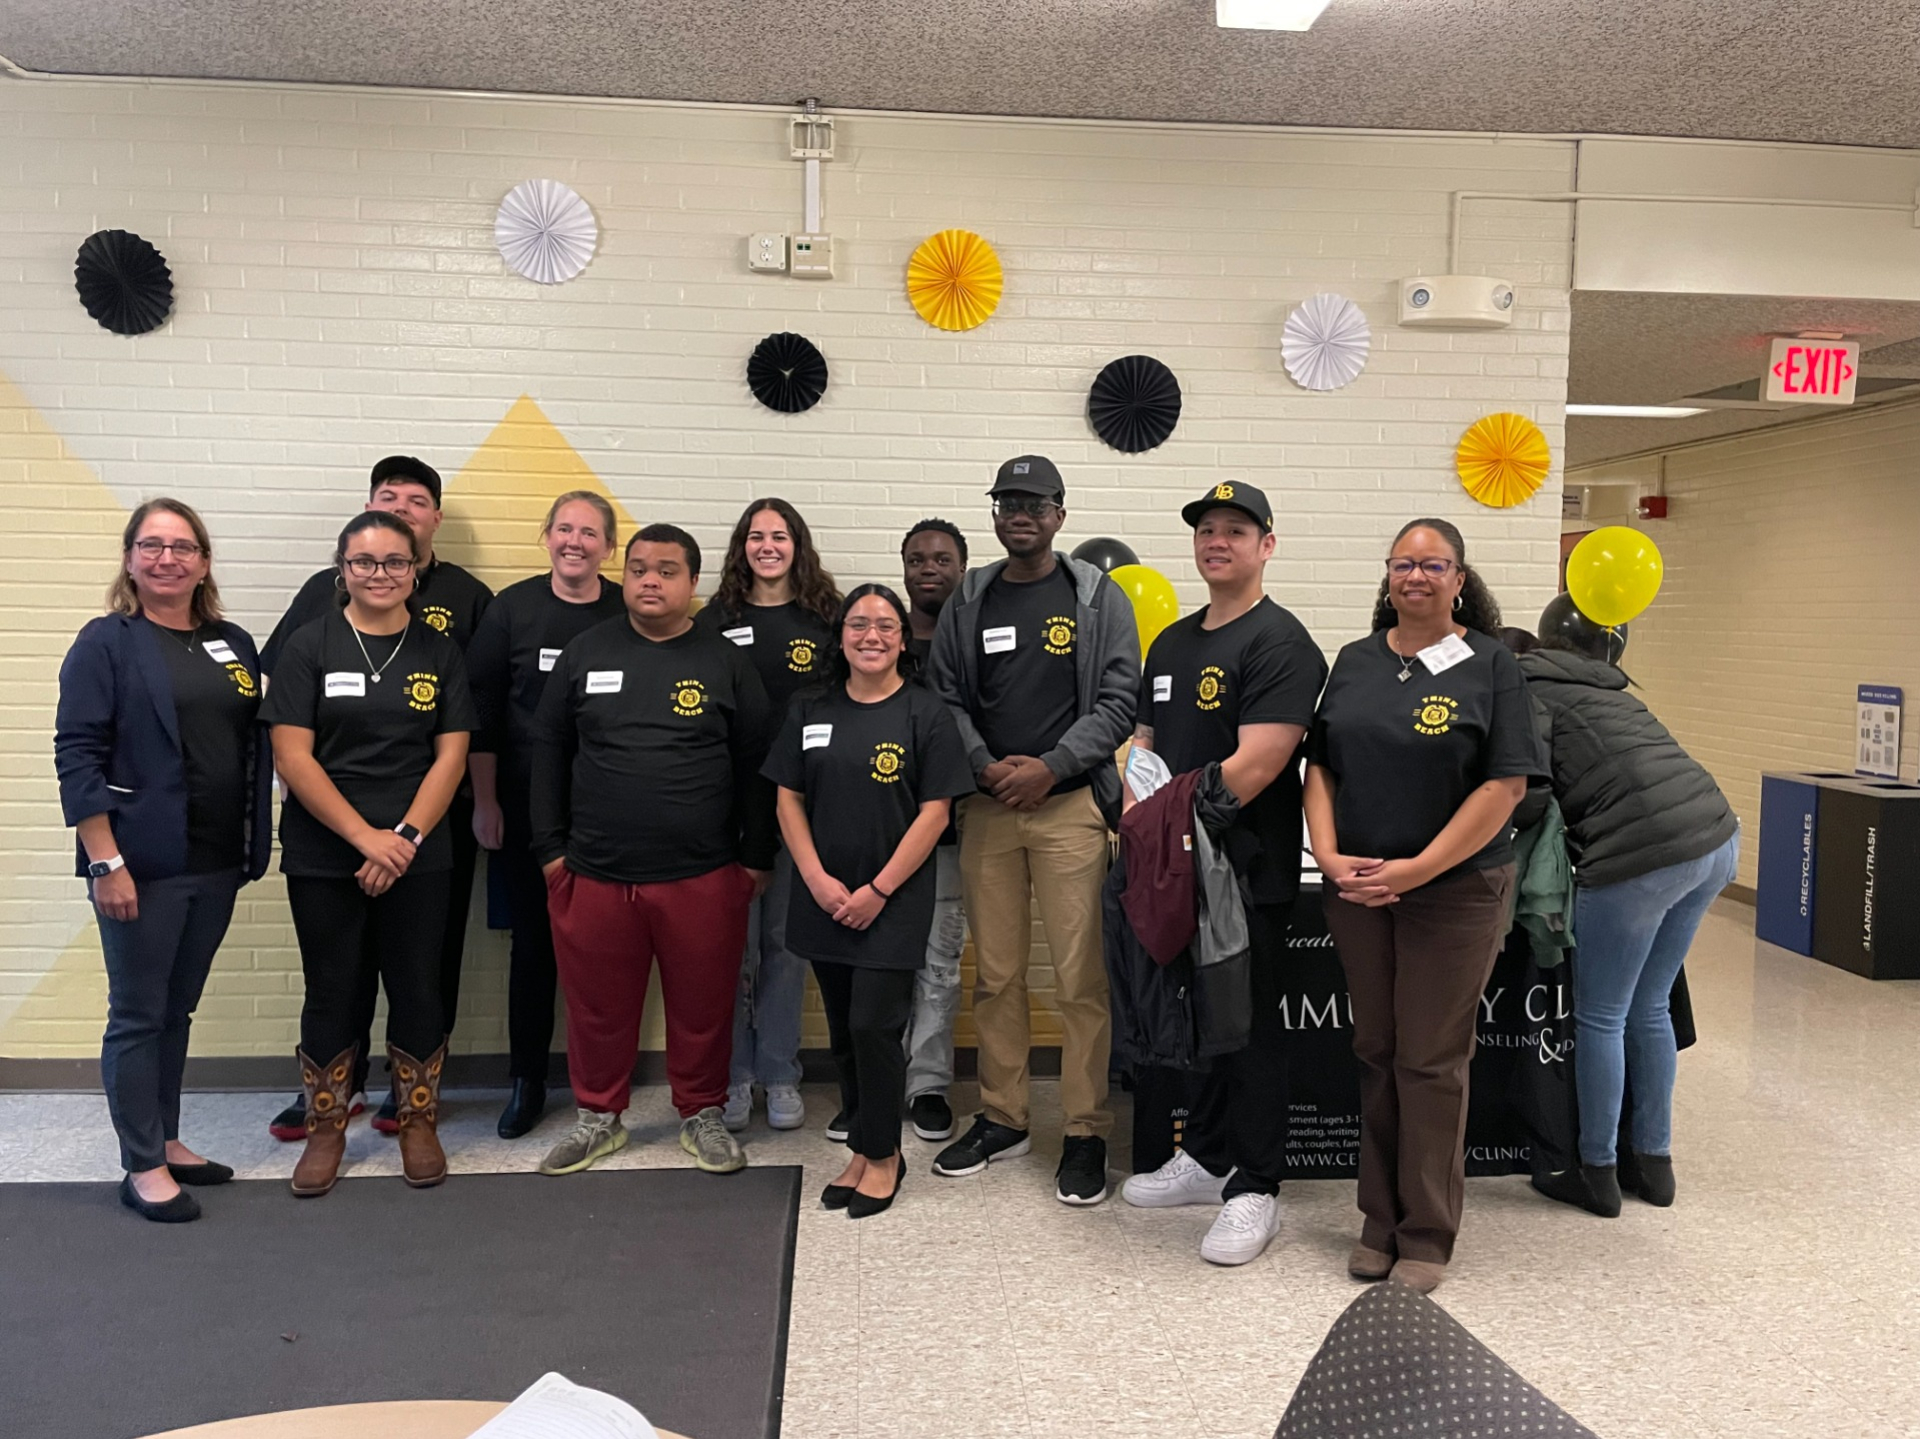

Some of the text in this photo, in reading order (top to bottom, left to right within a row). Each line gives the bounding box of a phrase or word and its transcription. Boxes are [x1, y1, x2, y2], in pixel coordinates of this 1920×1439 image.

[1783, 346, 1847, 396] EXIT
[1421, 696, 1459, 708] THINK
[673, 706, 704, 717] BEACH
[1413, 723, 1450, 735] BEACH
[875, 743, 906, 755] THINK
[871, 771, 899, 783] BEACH
[1800, 813, 1812, 905] RECYCLABLES
[1863, 826, 1876, 941] LANDFILL/TRASH
[1288, 1115, 1318, 1124] sment
[1320, 1115, 1344, 1126] (ages
[1328, 1127, 1360, 1138] writing
[1305, 1139, 1342, 1150] couples,
[1285, 1152, 1361, 1167] WWW.CE
